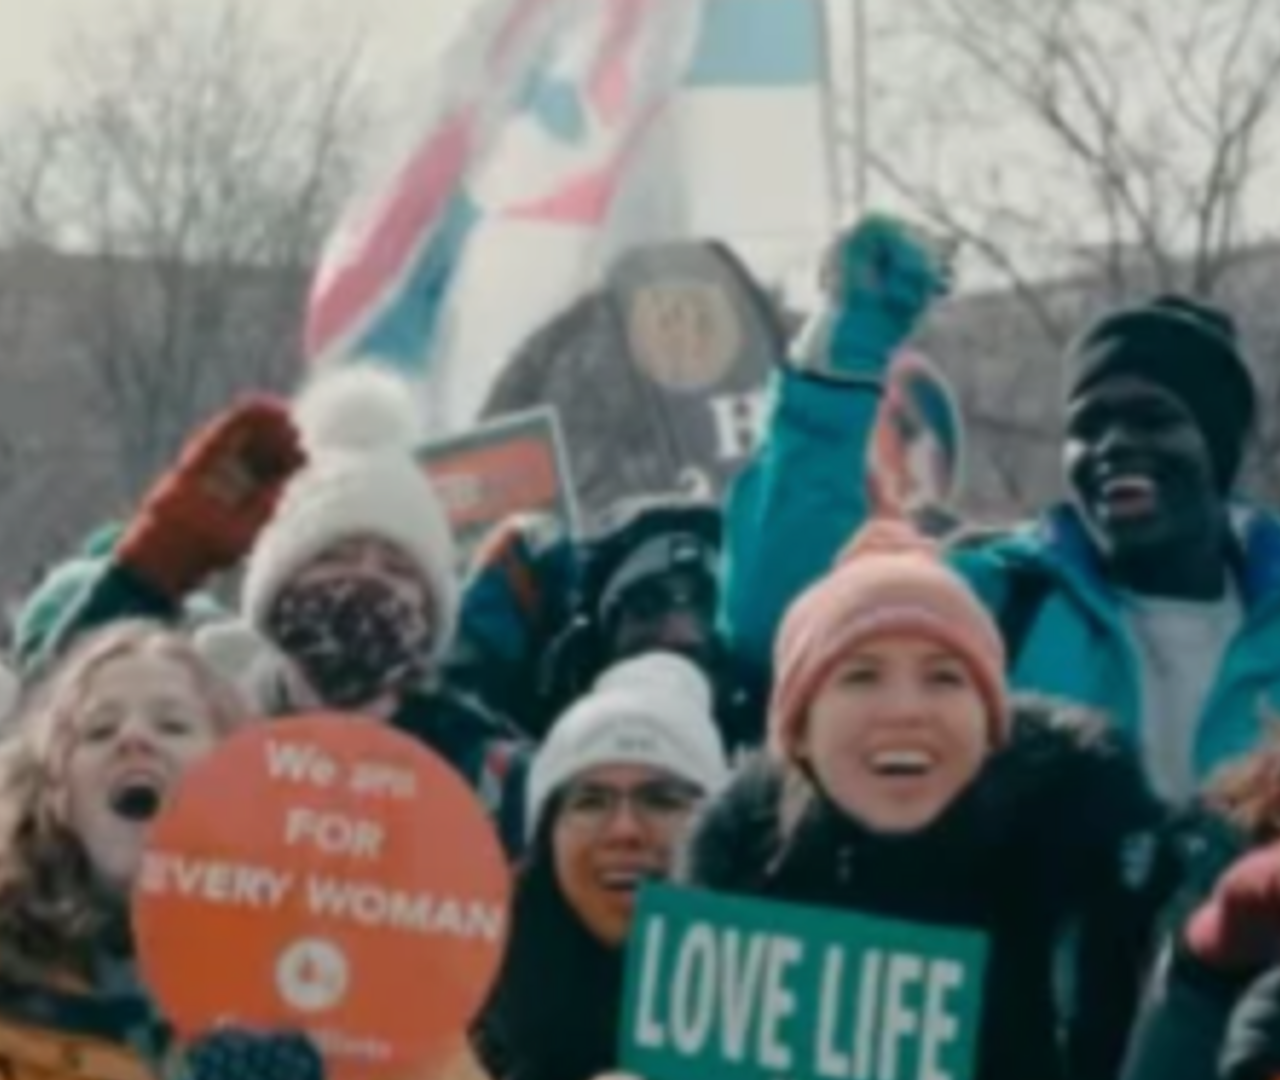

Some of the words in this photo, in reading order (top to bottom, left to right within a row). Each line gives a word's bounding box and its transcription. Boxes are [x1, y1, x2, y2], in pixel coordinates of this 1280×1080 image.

[265, 739, 337, 787] We
[285, 807, 385, 860] FOR
[308, 873, 504, 942] WOMAN
[633, 914, 804, 1071] LOVE
